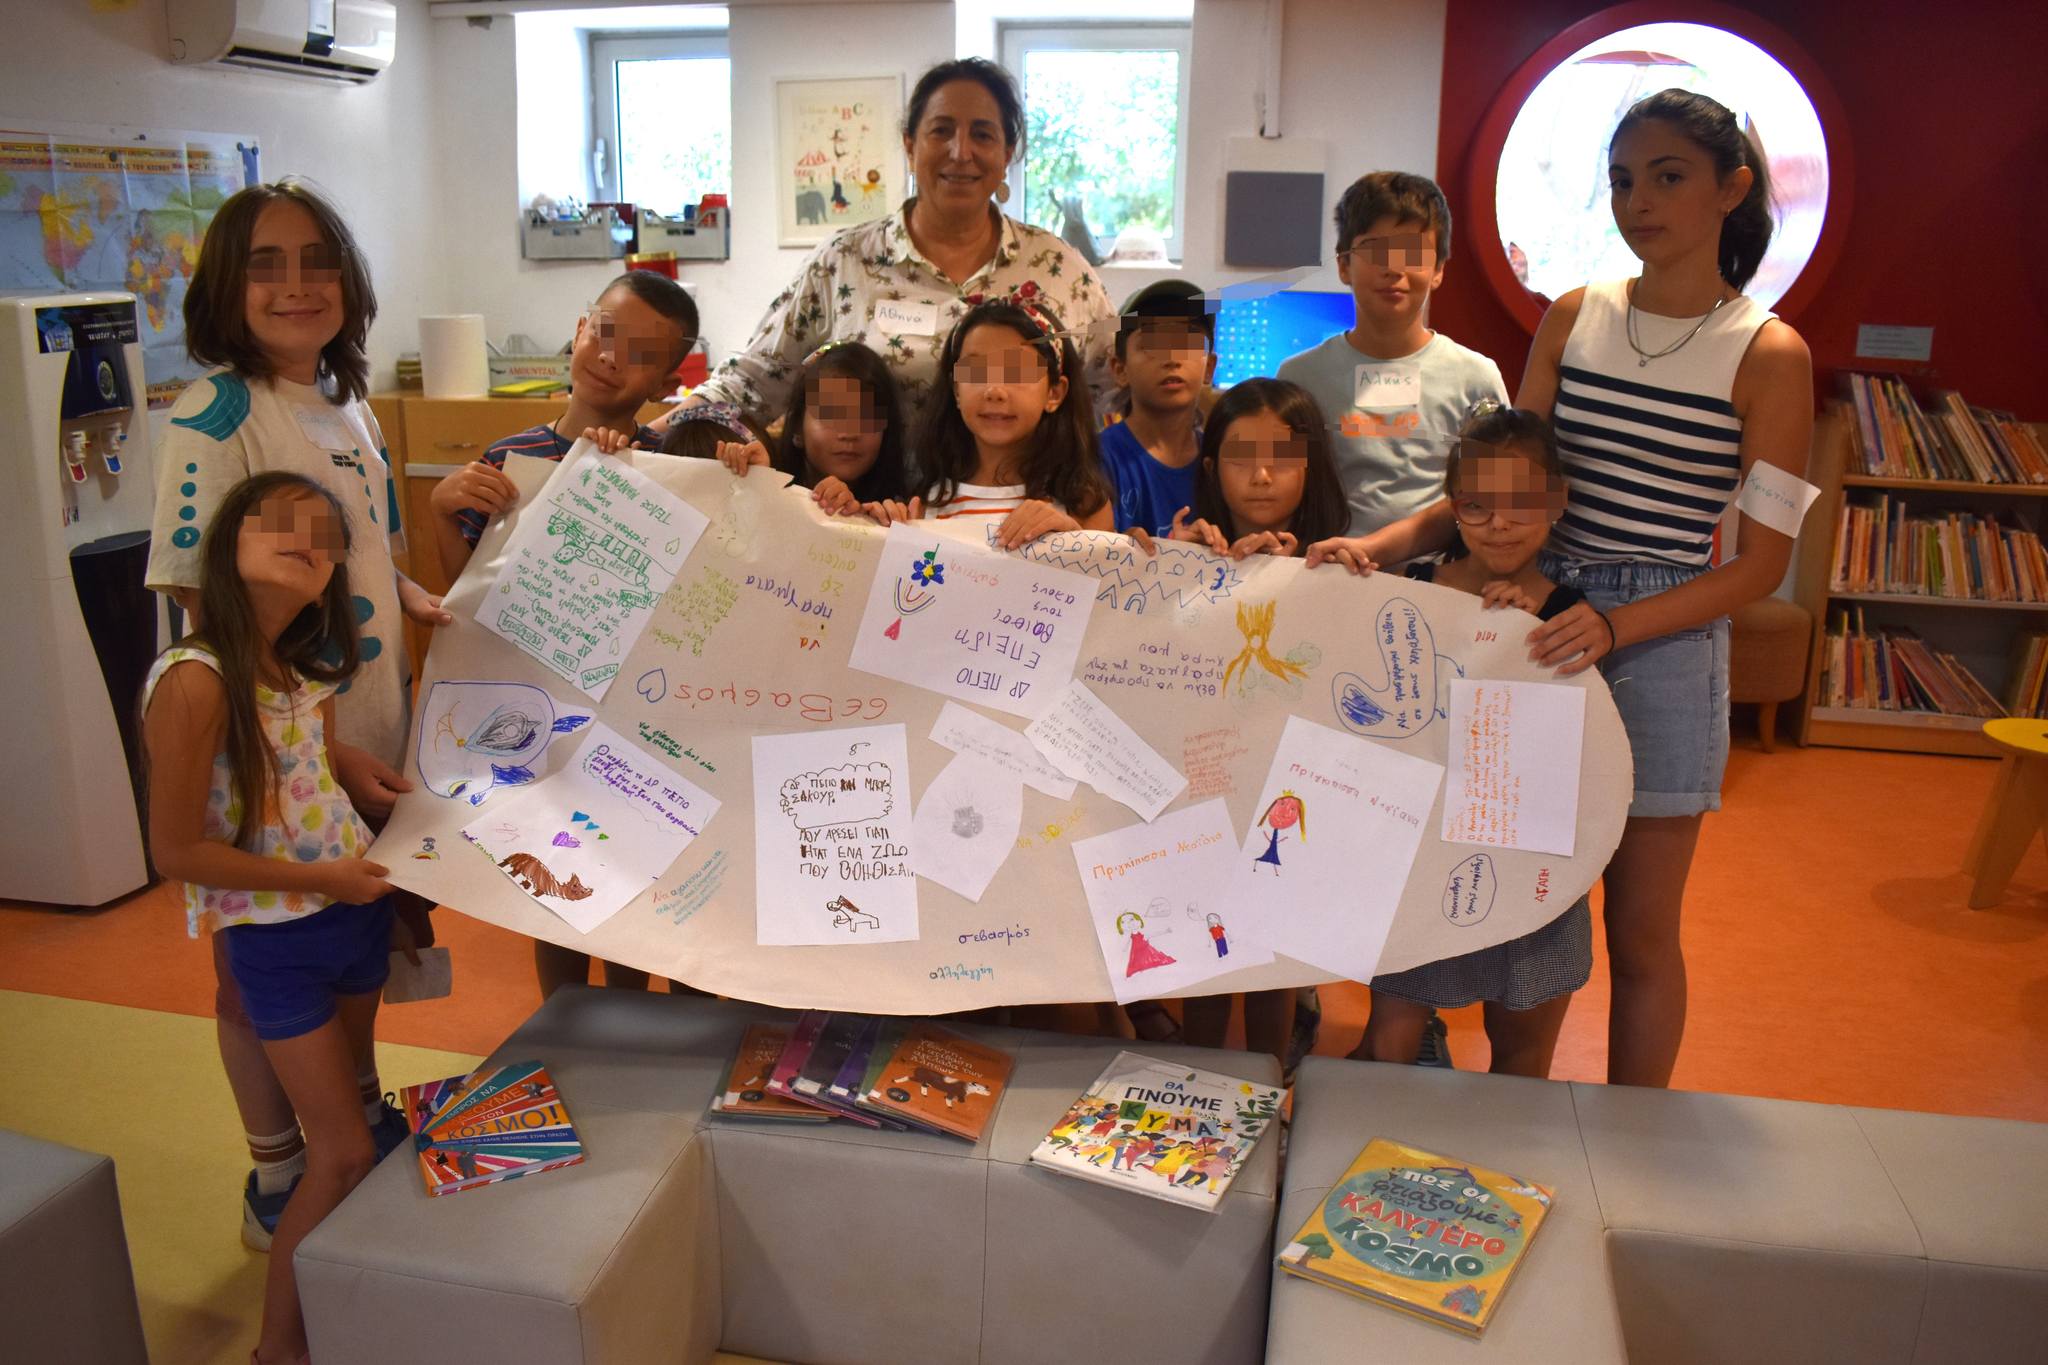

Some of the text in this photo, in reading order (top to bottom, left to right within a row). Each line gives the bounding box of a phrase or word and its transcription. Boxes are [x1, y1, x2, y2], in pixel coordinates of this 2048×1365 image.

[481, 1085, 497, 1097] ΝΑ
[1125, 1086, 1222, 1111] ΓΙΝΟΥΜΕ
[1165, 1081, 1184, 1091] ΘΑ
[1402, 1170, 1491, 1204] ΠΩΣ ΘΑ
[1334, 1220, 1484, 1277] ΚΟΣΜΟ
